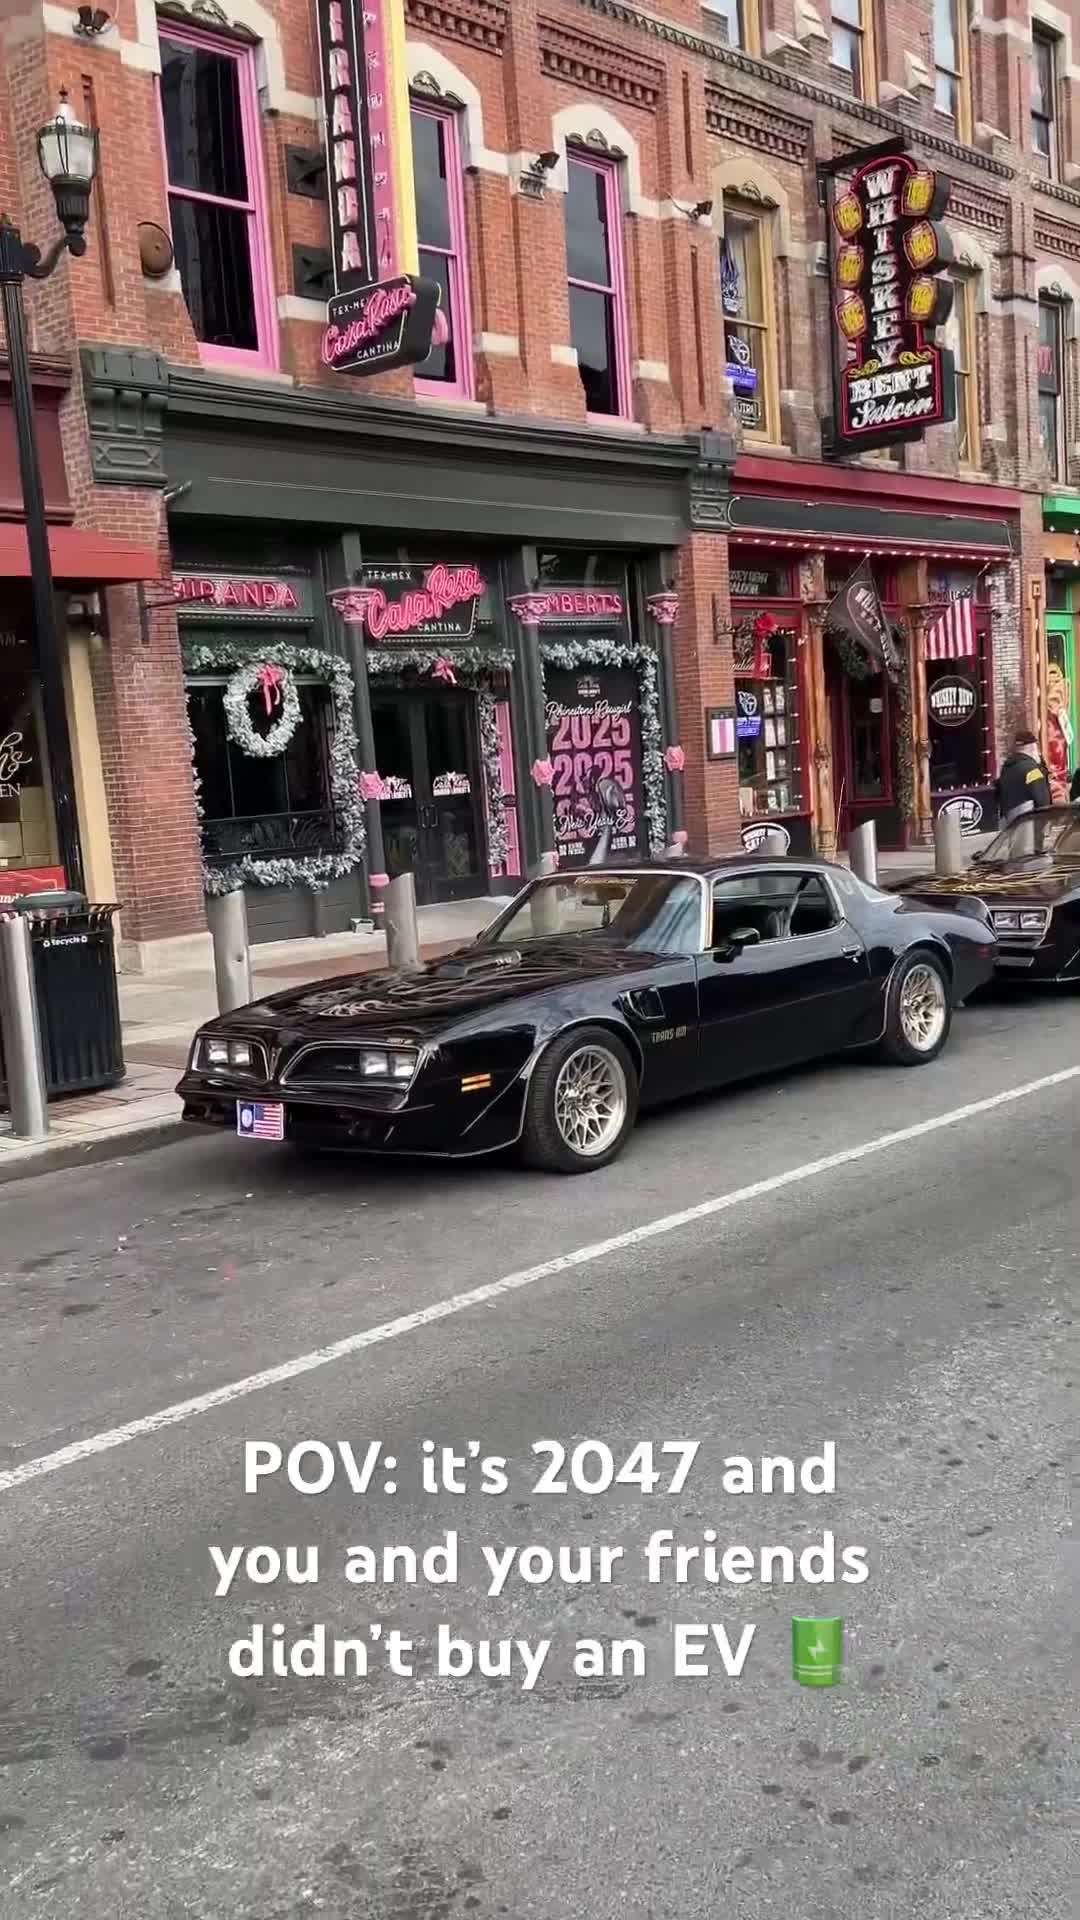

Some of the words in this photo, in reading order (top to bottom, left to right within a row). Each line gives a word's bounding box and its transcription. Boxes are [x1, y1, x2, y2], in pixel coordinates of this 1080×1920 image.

[863, 164, 904, 368] WHISKEY
[332, 299, 366, 316] TEX-ME
[321, 320, 369, 365] Casa
[356, 340, 399, 360] CANTINA
[848, 364, 933, 404] BENT
[851, 396, 935, 429] Saloon
[366, 569, 412, 581] TEX-MEX
[367, 589, 434, 640] Casa
[425, 563, 486, 609] Rosa
[417, 622, 463, 633] CANTINA
[551, 713, 632, 751] 2025
[553, 749, 634, 797] 2025
